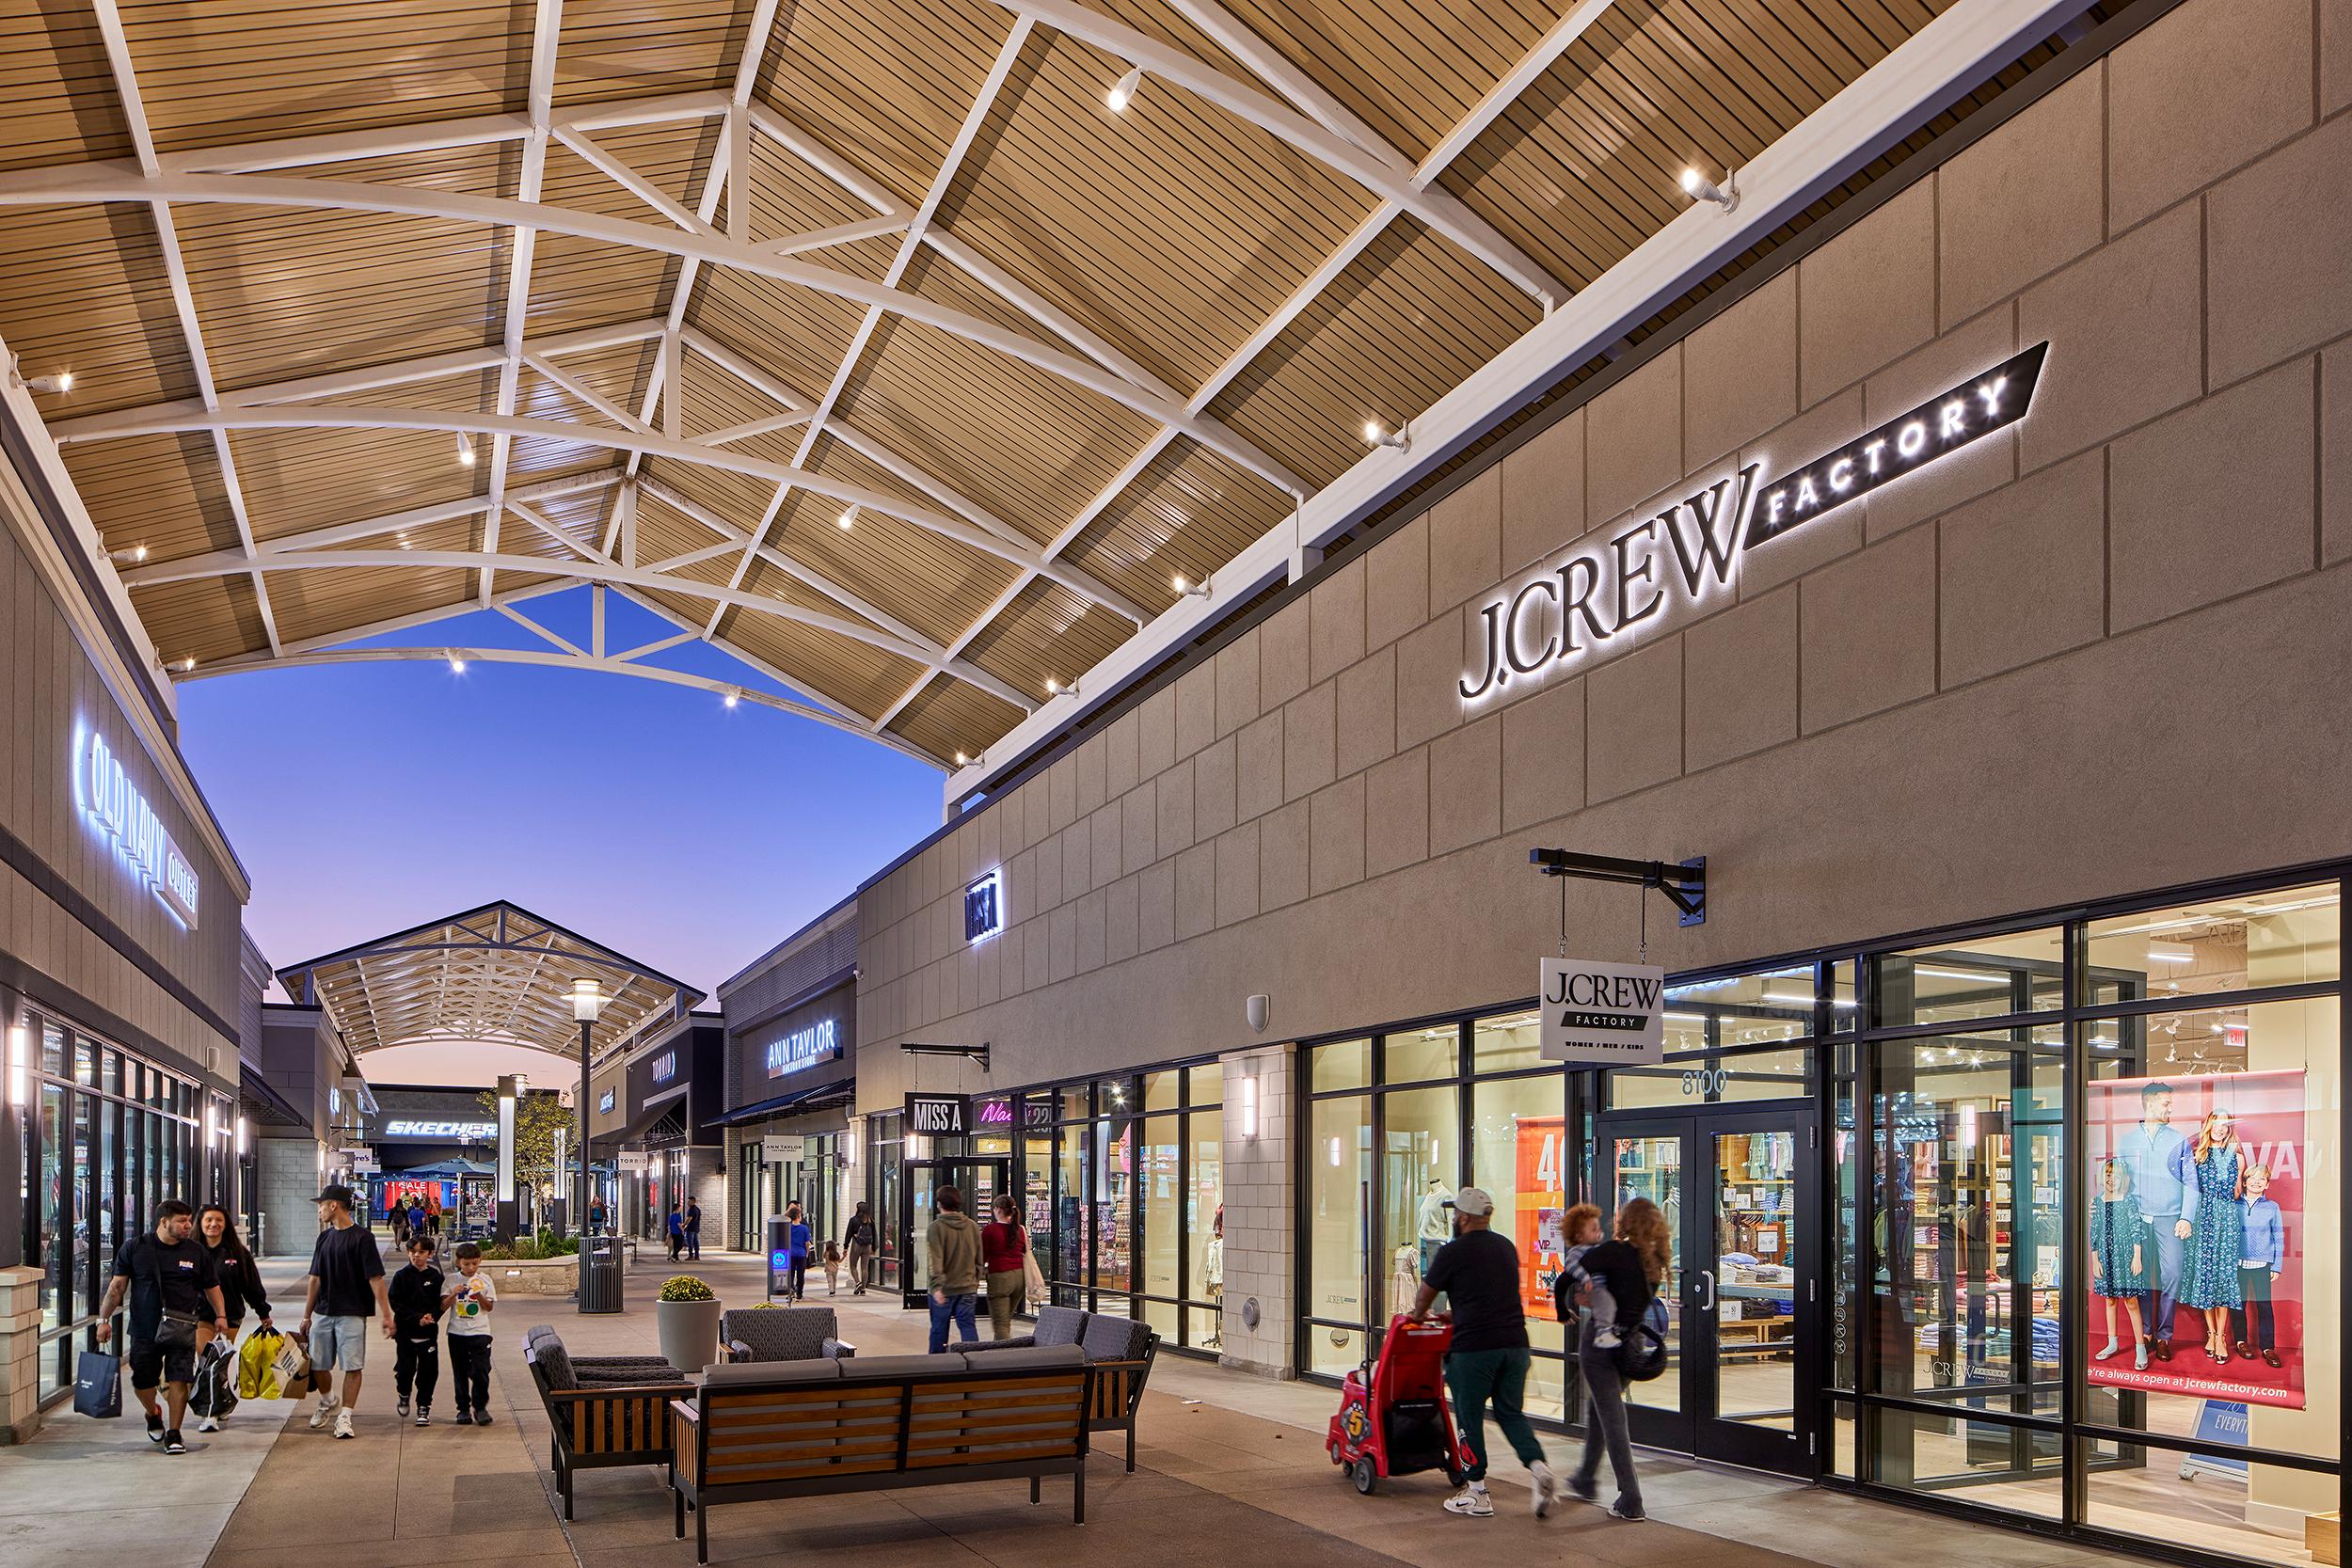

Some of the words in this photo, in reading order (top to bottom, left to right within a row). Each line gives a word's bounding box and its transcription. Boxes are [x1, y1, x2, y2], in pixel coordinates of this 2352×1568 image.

[1459, 463, 1761, 699] J.CREW
[1769, 377, 2008, 523] FACTORY
[92, 733, 124, 836] OLD
[125, 778, 166, 891] NAVY
[168, 851, 197, 913] OUTLET
[1546, 973, 1662, 1009] J.CREW
[1576, 1016, 1635, 1027] FACTORY
[769, 1037, 791, 1069] ANN
[791, 1020, 834, 1061] TAYLOR
[1681, 1069, 1727, 1095] 8100
[914, 1103, 949, 1131] MISS
[951, 1103, 962, 1132] A
[1536, 1133, 1565, 1193] 4
[280, 1351, 297, 1377] NIKE
[2107, 1370, 2140, 1383] always
[2143, 1374, 2169, 1386] open
[2173, 1377, 2184, 1386] at
[2184, 1379, 2288, 1398] jcrewfactory.com
[1349, 1412, 1363, 1436] 5
[2215, 1414, 2249, 1434] EVERYT
